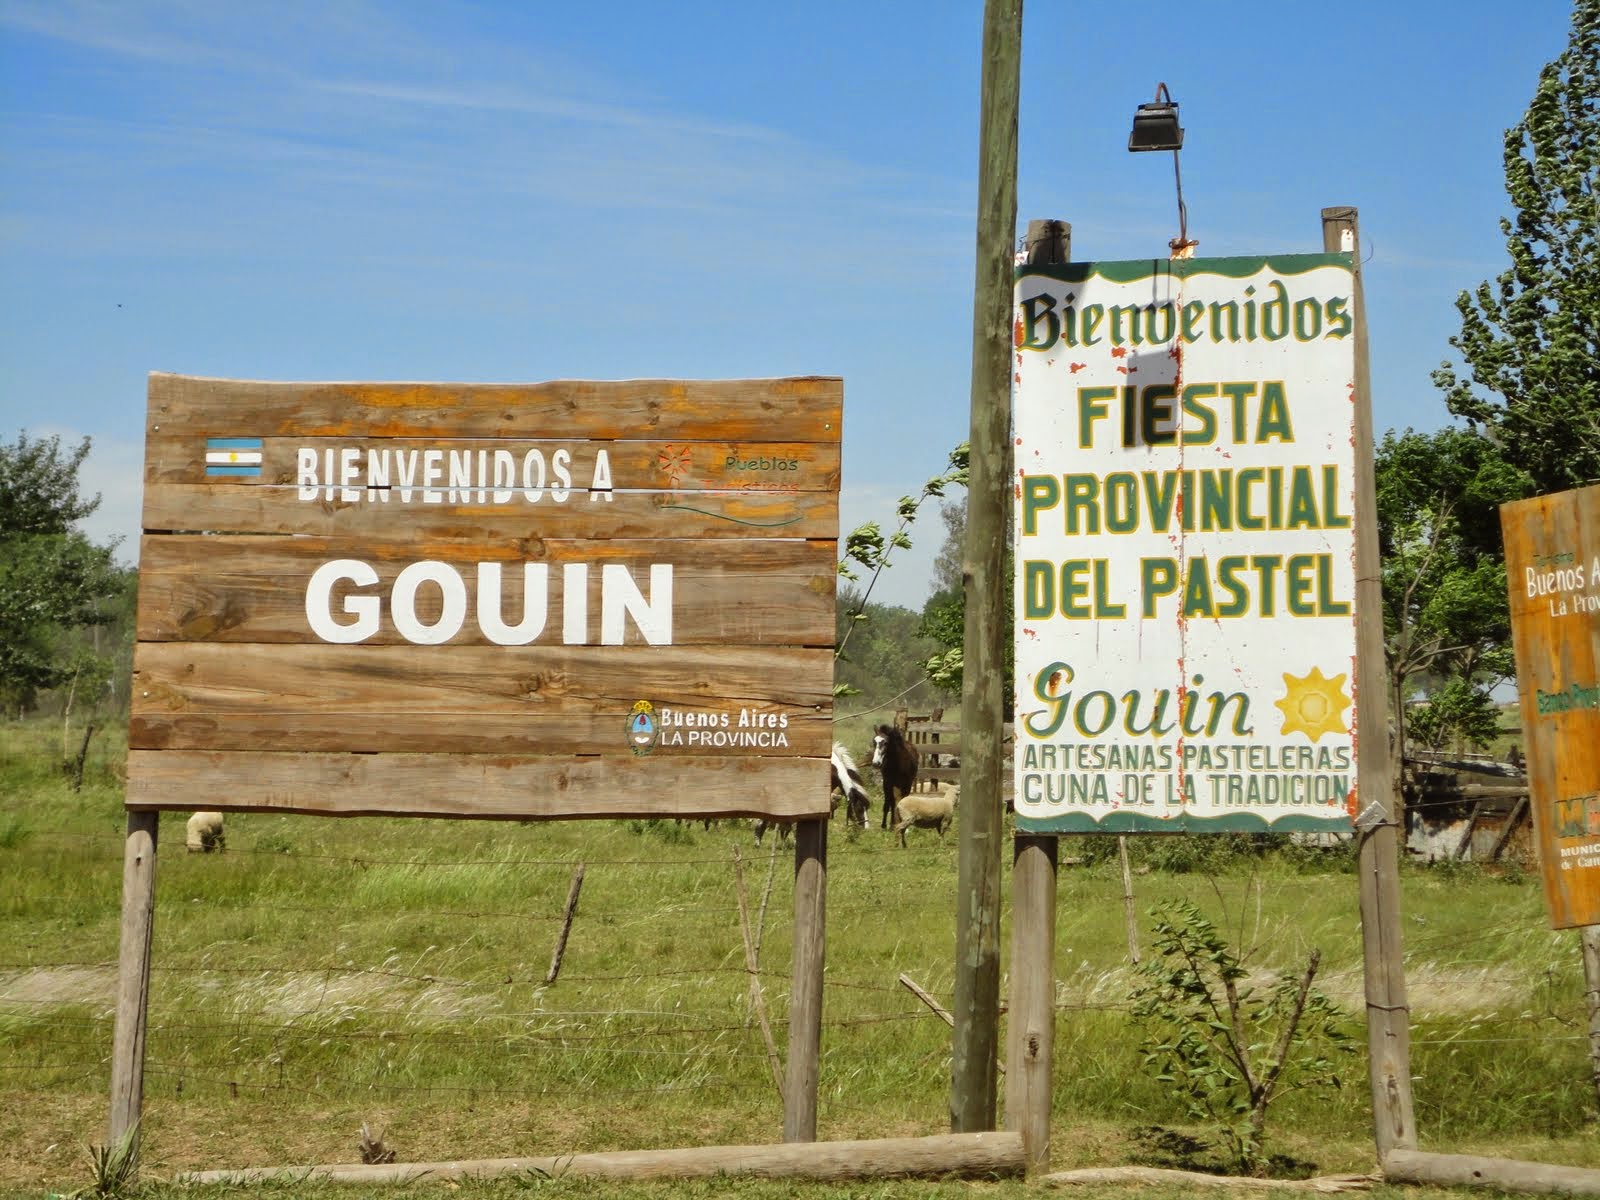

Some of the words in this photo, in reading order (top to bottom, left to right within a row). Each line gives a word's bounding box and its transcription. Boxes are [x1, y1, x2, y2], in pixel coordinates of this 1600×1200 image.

[1015, 280, 1353, 353] Bienvenidos
[1077, 380, 1296, 450] FIESTA
[296, 447, 571, 505] BIENVENIDOS
[591, 449, 613, 502] A
[725, 456, 798, 471] Pueblos
[1022, 464, 1351, 537] PROVINCIAL
[305, 559, 674, 646] GOUIN
[1023, 558, 1127, 620] DEL
[1140, 553, 1351, 619] PASTEL
[1526, 566, 1585, 598] Buenos
[1550, 598, 1567, 617] La
[661, 708, 729, 727] Buenos
[738, 708, 788, 729] Aires
[1023, 661, 1254, 739] Gouin
[661, 731, 683, 746] LA
[688, 731, 788, 748] PROVINCIA
[1023, 743, 1173, 773] ARTESANAS
[1181, 744, 1351, 772] PASTELERAS
[1023, 773, 1110, 806] CUNA
[1121, 774, 1156, 806] DE
[1164, 774, 1198, 806] LA
[1210, 774, 1350, 808] TRADICION
